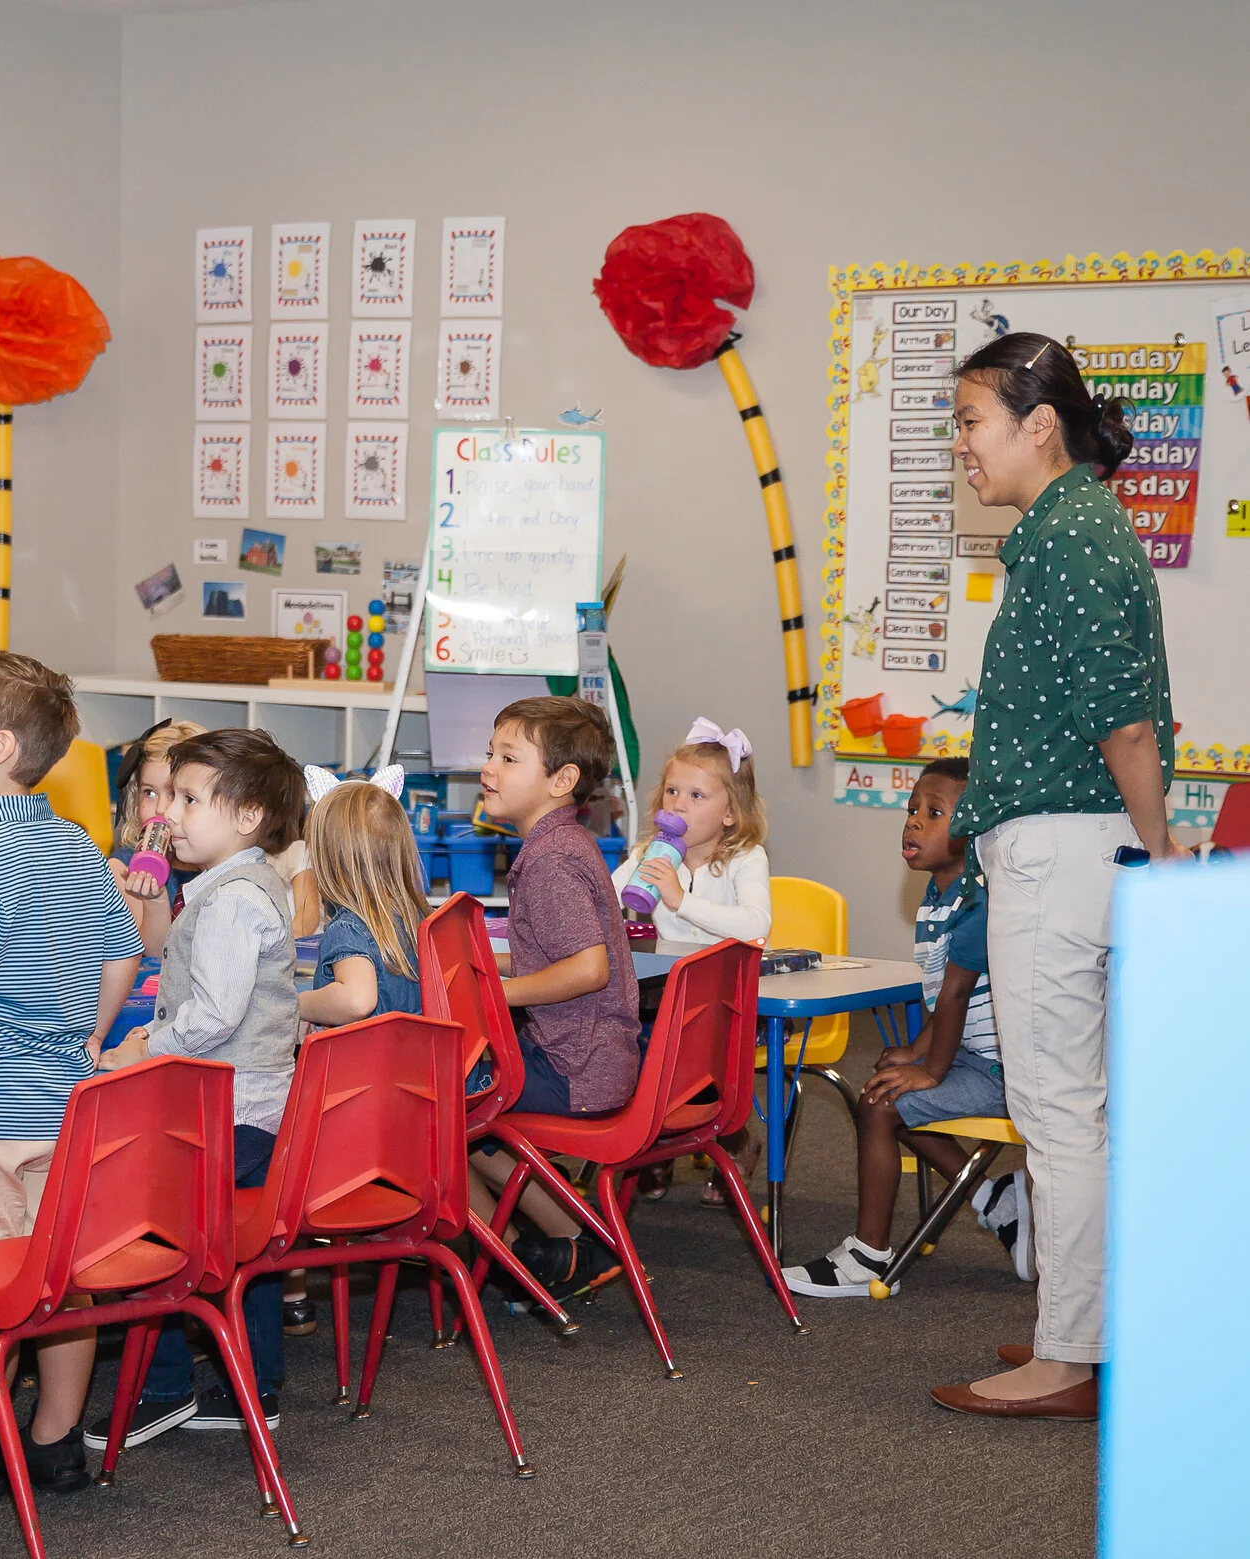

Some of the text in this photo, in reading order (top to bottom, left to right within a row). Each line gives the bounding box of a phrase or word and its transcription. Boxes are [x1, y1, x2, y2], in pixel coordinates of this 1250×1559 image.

[899, 306, 949, 319] Our Day
[899, 337, 930, 345] Arrival
[1071, 348, 1184, 373] Sunday
[895, 364, 932, 373] Calendar
[901, 394, 927, 404] Circle
[896, 426, 929, 434] Recess
[1122, 411, 1180, 438] sday
[457, 437, 513, 464] Class
[1123, 442, 1198, 470] esday
[894, 456, 937, 465] Bathroom
[446, 468, 461, 495] 1.
[894, 488, 932, 497] Centers
[1111, 475, 1191, 501] rsday
[466, 508, 512, 527] Lten
[894, 517, 932, 526] Specials
[441, 535, 458, 562] 3.
[505, 551, 522, 564] up
[892, 543, 937, 552] Bathroom
[964, 540, 995, 551] Lunch
[891, 567, 928, 577] Centers
[438, 568, 458, 597] 4.
[892, 596, 927, 607] Writing
[887, 623, 927, 634] Clean Up
[436, 635, 506, 664] 6. Smile
[887, 654, 925, 665] Pack Up
[846, 767, 917, 790] Aa Bb
[1185, 784, 1214, 808] Hh
